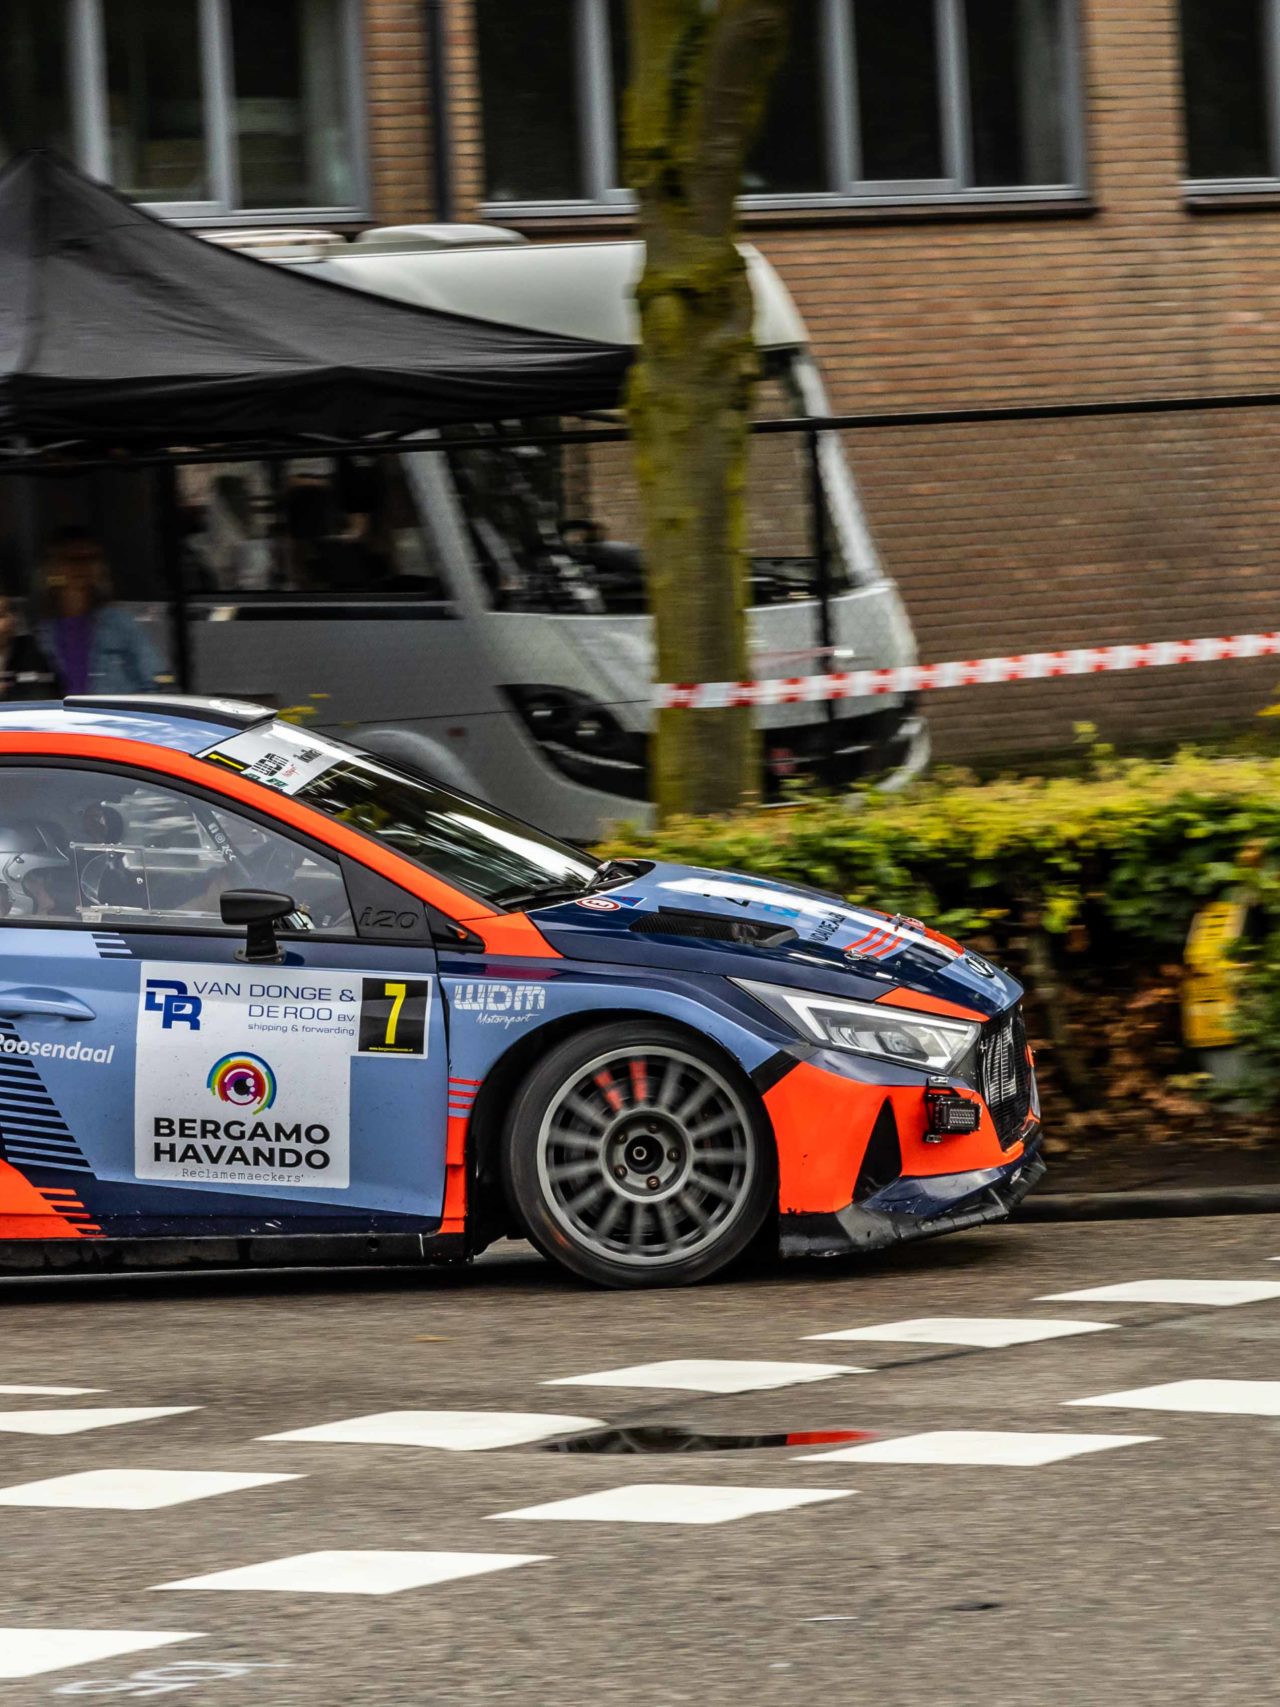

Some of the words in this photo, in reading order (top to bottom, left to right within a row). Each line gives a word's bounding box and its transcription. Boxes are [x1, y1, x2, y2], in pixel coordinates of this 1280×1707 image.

[359, 906, 419, 929] i20
[194, 981, 240, 996] VAN
[250, 984, 331, 1001] DONGE
[339, 989, 356, 1002] &
[454, 984, 546, 1010] WDM
[248, 1005, 280, 1018] DE
[284, 1006, 332, 1021] ROO
[385, 983, 406, 1044] 7
[476, 1012, 541, 1030] Motorsport
[248, 1023, 288, 1033] shipping
[291, 1024, 299, 1032] &
[302, 1025, 355, 1036] forwarding
[154, 1117, 330, 1144] BERGAMO
[154, 1142, 330, 1169] HAVANDO
